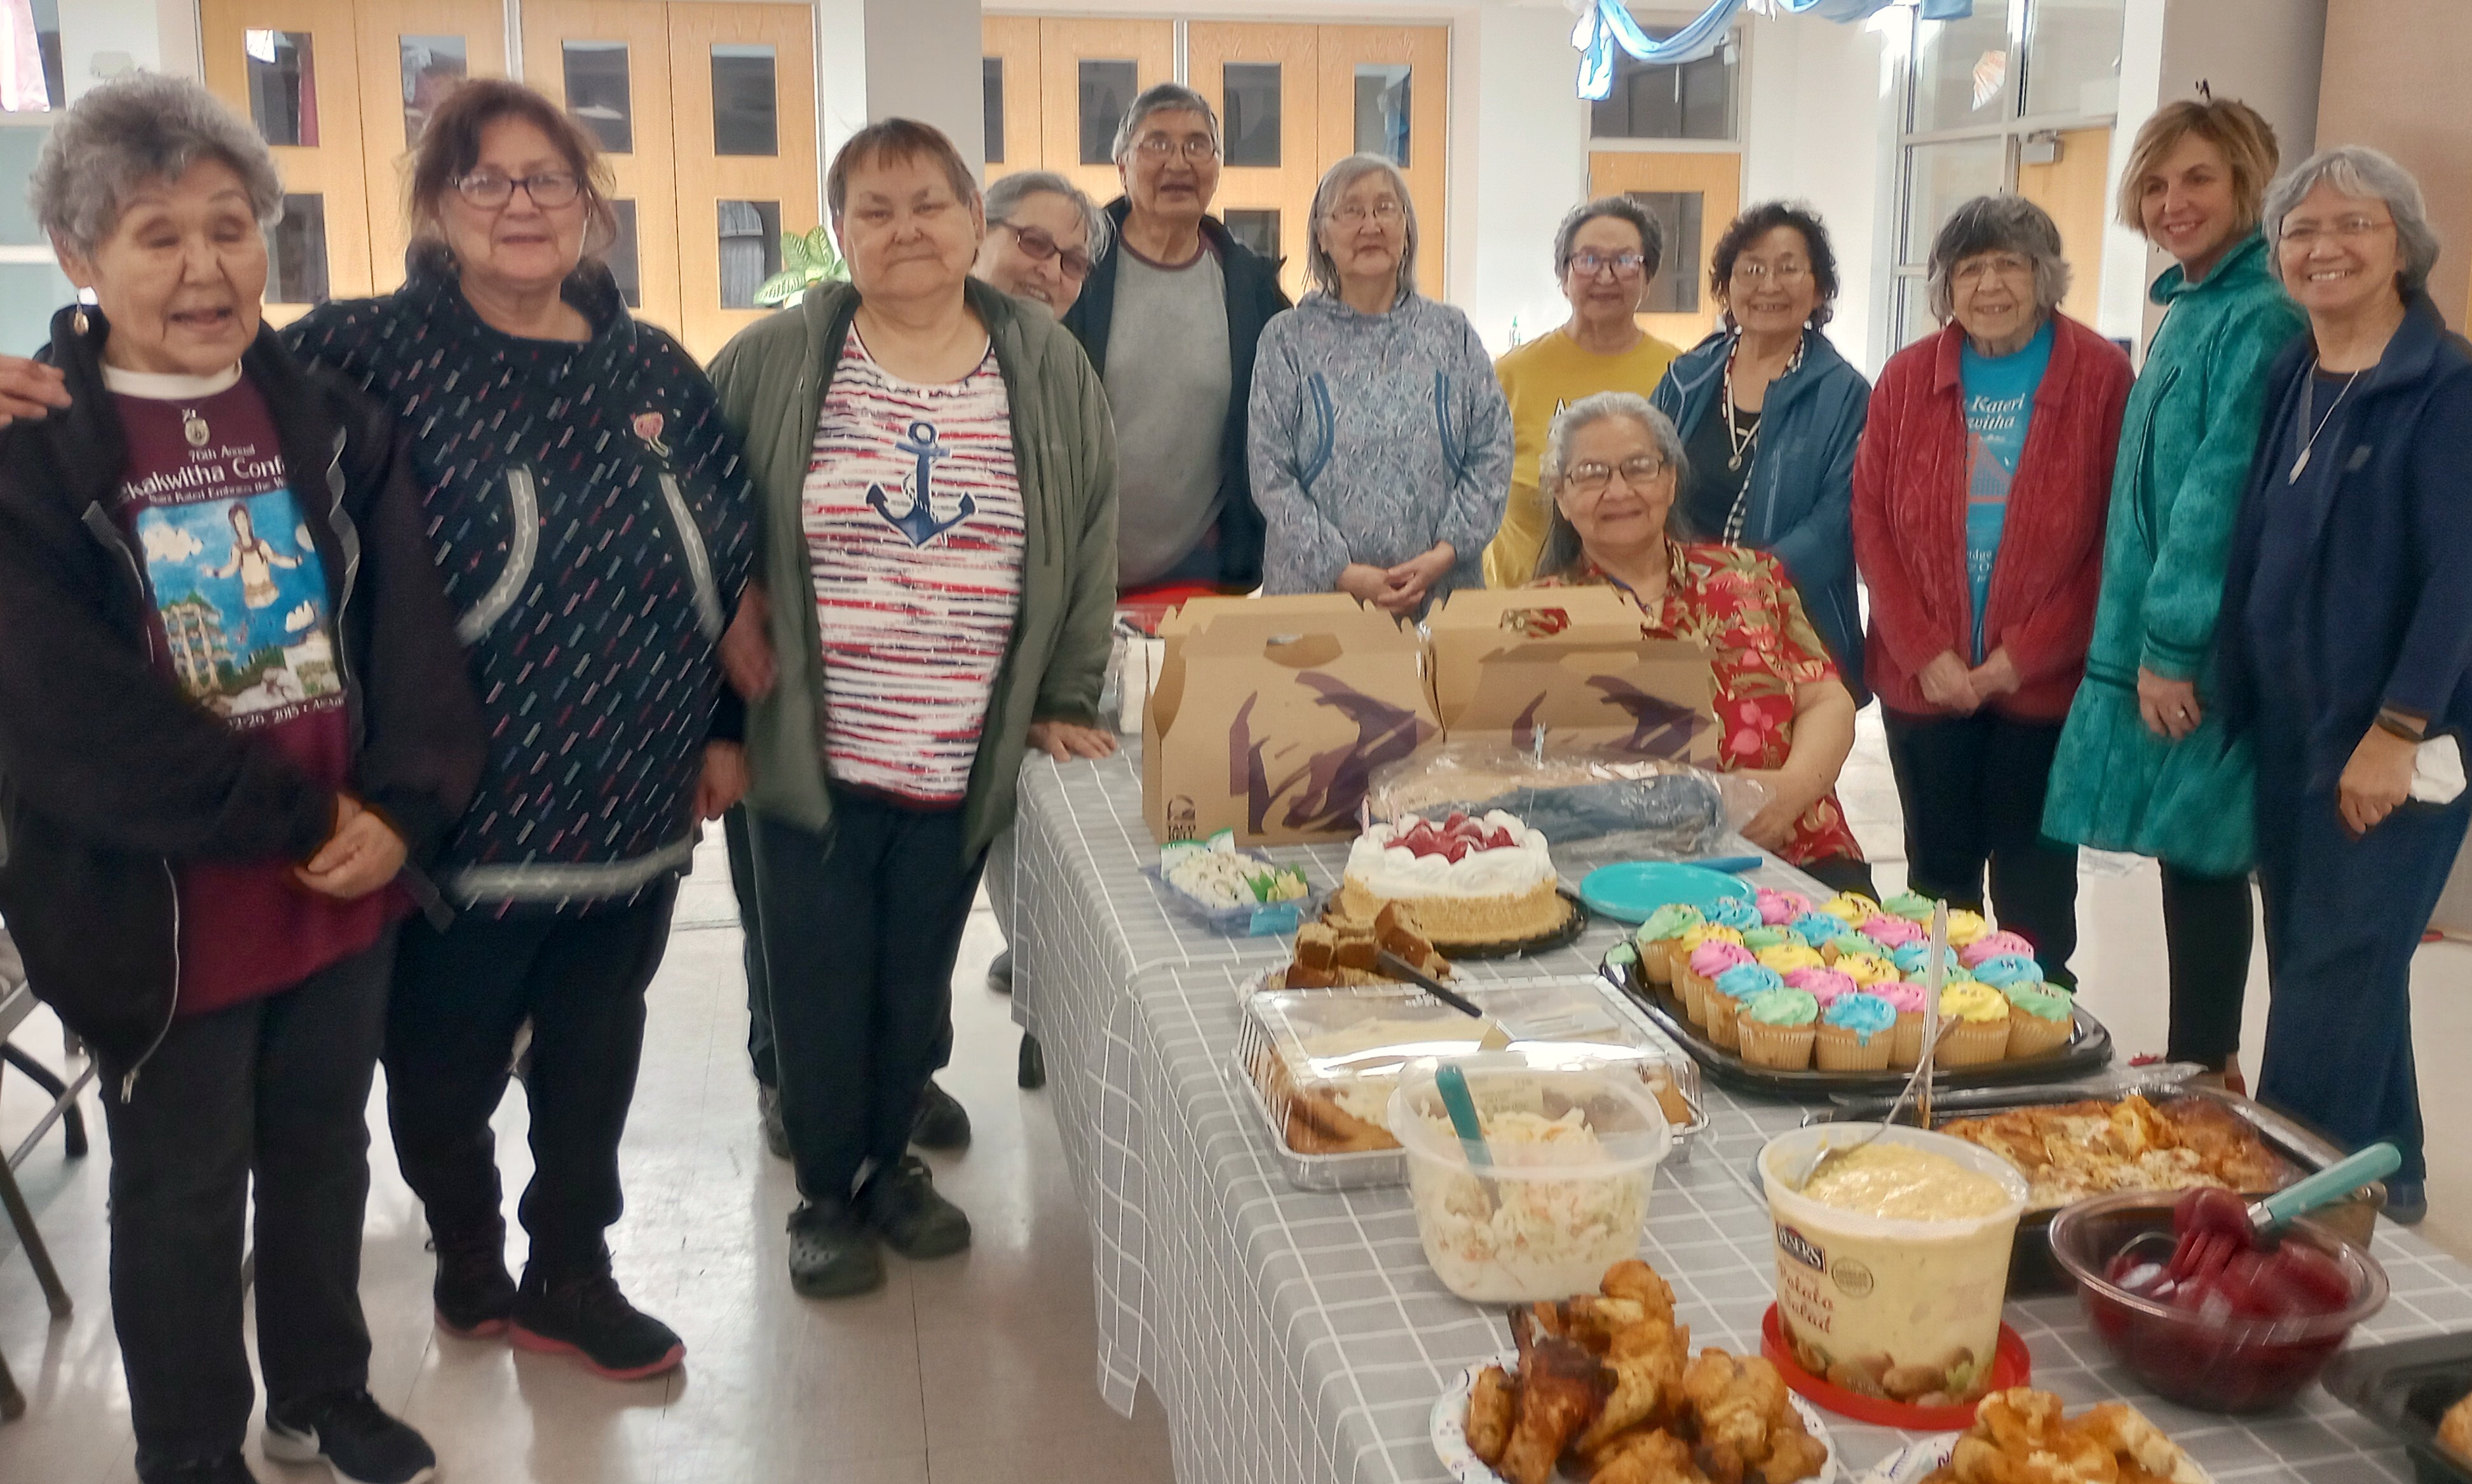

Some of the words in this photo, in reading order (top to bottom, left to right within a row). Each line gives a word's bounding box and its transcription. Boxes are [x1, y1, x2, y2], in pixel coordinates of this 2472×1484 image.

[1972, 393, 2025, 412] Kateri
[221, 443, 255, 458] Annual
[175, 489, 205, 503] Kateri
[1779, 1258, 1834, 1312] Potato
[1784, 1288, 1831, 1333] Salad
